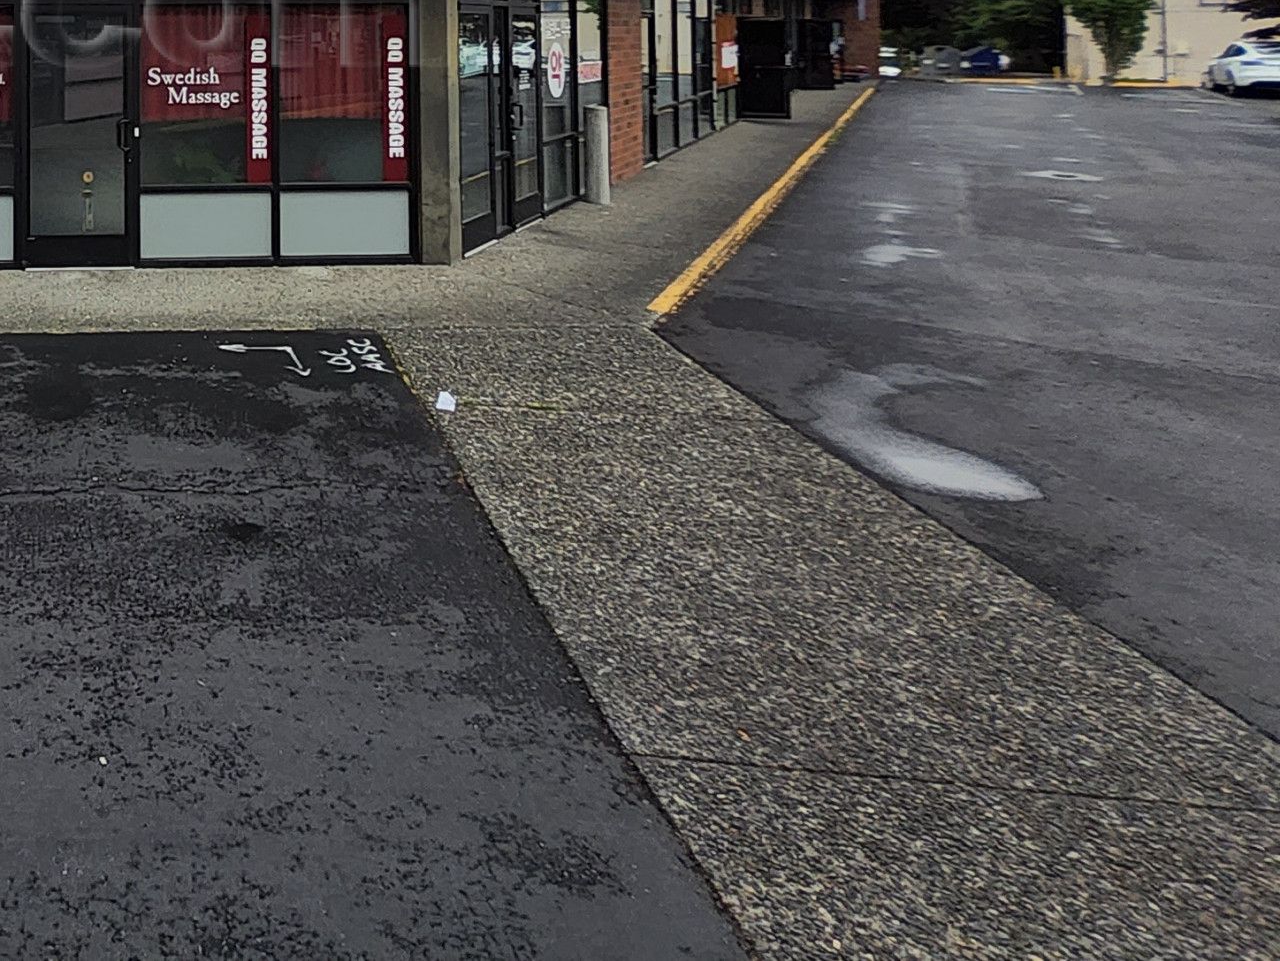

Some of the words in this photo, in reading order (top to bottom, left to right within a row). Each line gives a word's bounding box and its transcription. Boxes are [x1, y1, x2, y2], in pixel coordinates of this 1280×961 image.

[250, 38, 268, 64] QQ
[387, 37, 405, 63] QQ
[147, 66, 220, 86] Swedish
[167, 86, 240, 109] Massage
[250, 68, 268, 160] MASSAGE
[387, 67, 405, 158] MASSAGE
